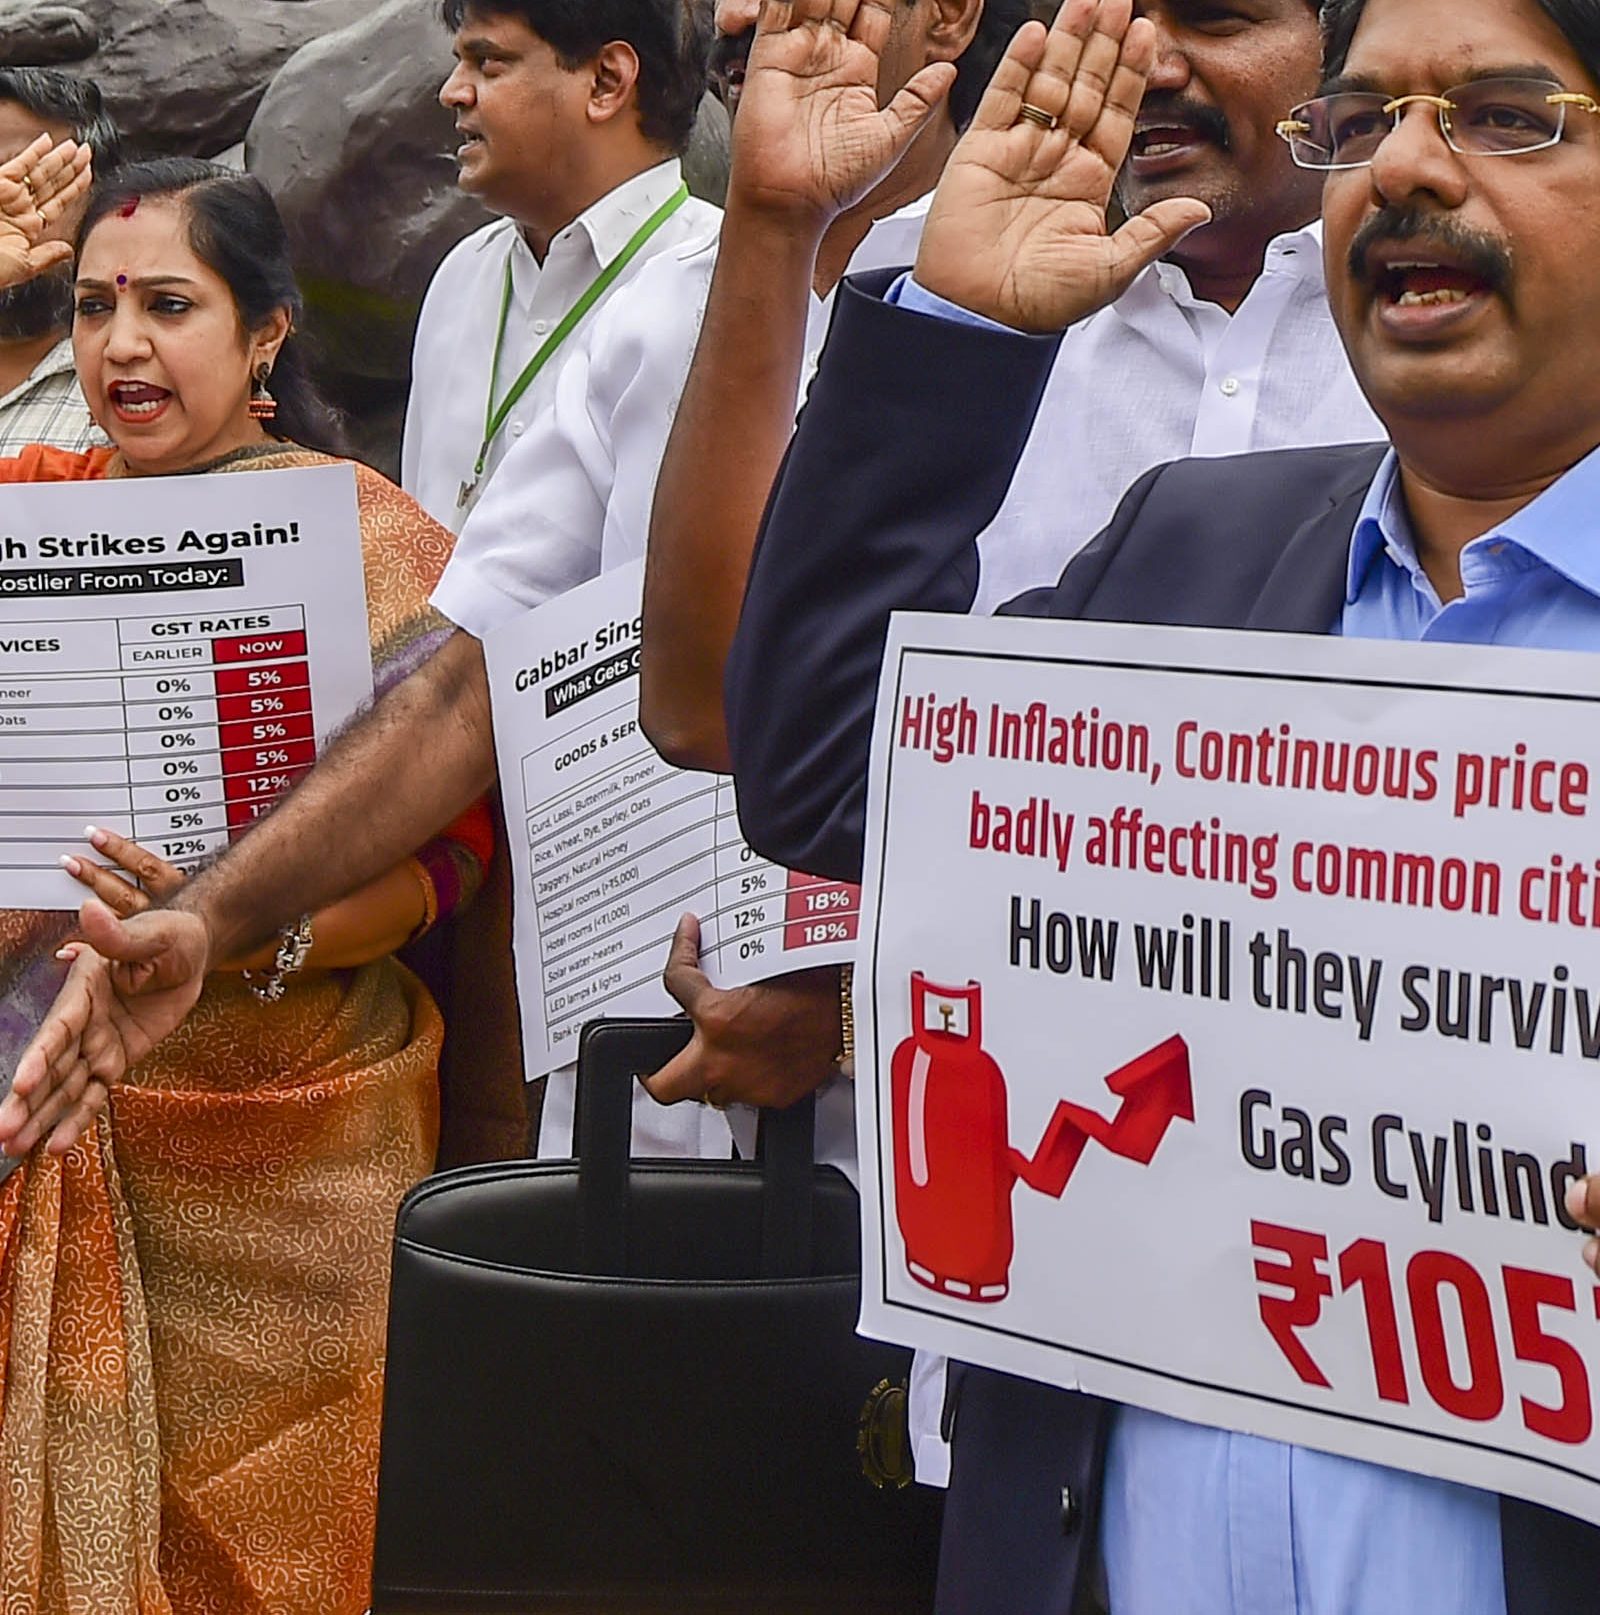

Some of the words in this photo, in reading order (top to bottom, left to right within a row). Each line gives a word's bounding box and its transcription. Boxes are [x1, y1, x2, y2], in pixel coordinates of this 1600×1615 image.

[38, 533, 165, 558] Strikes
[177, 522, 300, 555] Again!
[80, 572, 142, 589] From
[149, 567, 229, 586] Today:
[151, 621, 193, 636] GST
[200, 615, 271, 633] RATES
[133, 647, 203, 662] EARLIER
[239, 639, 284, 654] NOW
[515, 641, 589, 692] Gabbar
[595, 617, 643, 652] Sing
[156, 679, 191, 694] 0%
[248, 670, 282, 687] 5%
[553, 675, 592, 706] What
[594, 658, 628, 685] Gets
[158, 705, 193, 720] 0%
[251, 697, 284, 713] 5%
[253, 723, 286, 739] 5%
[161, 733, 195, 748] 0%
[256, 749, 289, 766] 5%
[554, 739, 597, 771] GOODS
[600, 734, 608, 748] &
[899, 692, 977, 767] High
[989, 703, 1162, 785] Inflation,
[1175, 721, 1438, 802] Continuous
[1455, 743, 1588, 820] price
[163, 760, 198, 776] 0%
[248, 774, 290, 792] 12%
[165, 787, 200, 802] 0%
[630, 797, 652, 815] Oats
[170, 813, 203, 829] 5%
[163, 839, 206, 856] 12%
[970, 791, 1073, 872] badly
[1085, 815, 1278, 899] affecting
[1292, 840, 1499, 916] common
[740, 873, 767, 894] 5%
[806, 890, 850, 912] 18%
[734, 906, 765, 929] 12%
[804, 922, 848, 943] 18%
[740, 938, 765, 959] 0%
[1010, 895, 1118, 980] How
[1134, 912, 1231, 1002] will
[1250, 929, 1380, 1041] they
[550, 996, 566, 1013] LED
[552, 1025, 572, 1044] Bank
[1240, 1088, 1351, 1187] Gas
[1372, 1113, 1597, 1234] Cylind
